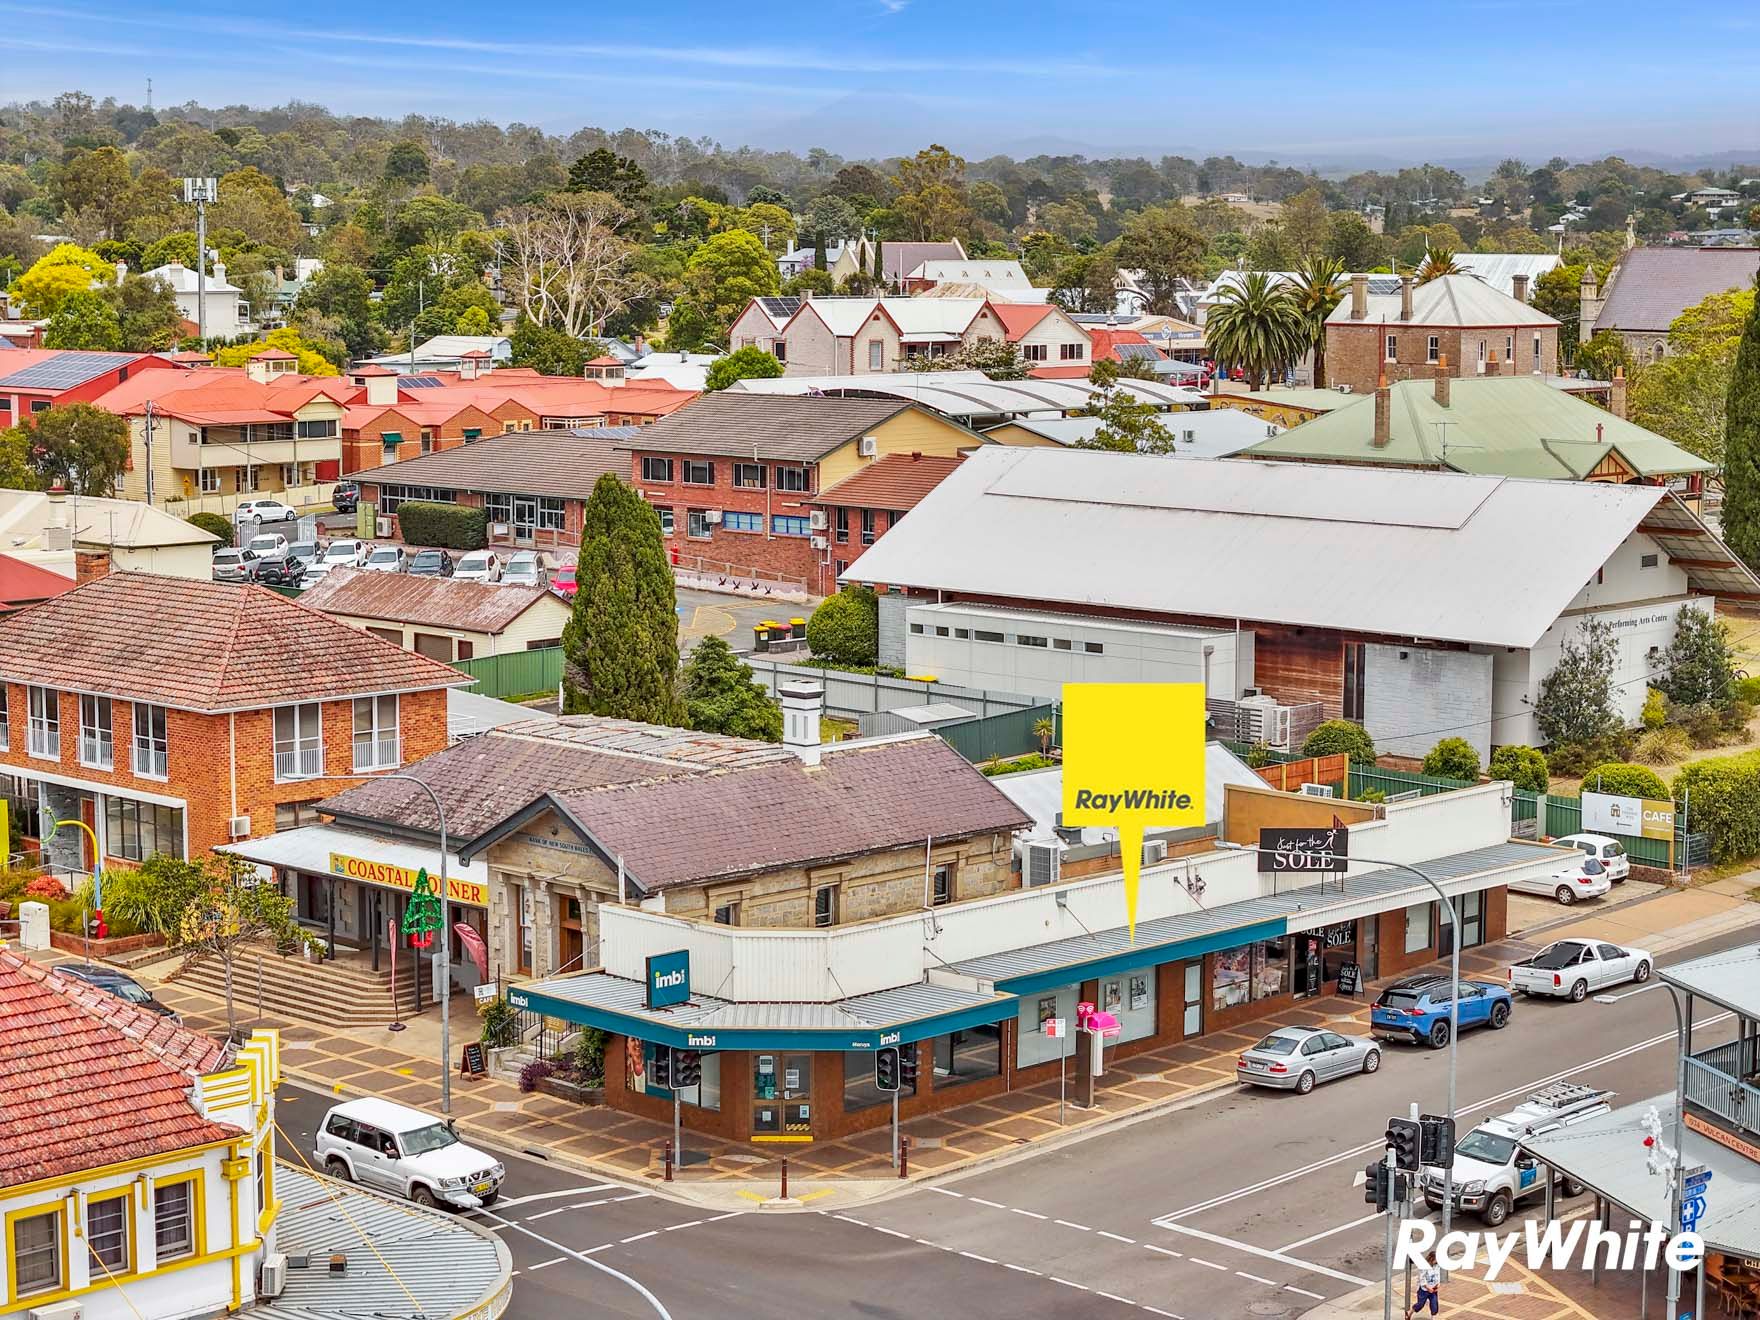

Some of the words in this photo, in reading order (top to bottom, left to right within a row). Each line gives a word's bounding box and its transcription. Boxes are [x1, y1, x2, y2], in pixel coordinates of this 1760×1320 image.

[1638, 617, 1650, 625] Arts
[1650, 614, 1668, 623] Centre
[1642, 810, 1672, 824] CAFE
[529, 836, 542, 844] BANK
[560, 842, 574, 850] SOUTH
[1307, 834, 1322, 847] the
[1273, 850, 1334, 869] SOLE
[348, 859, 413, 888] COASTAL
[1327, 930, 1351, 948] SOLE
[1703, 1125, 1731, 1143] VULCAN
[1731, 1139, 1758, 1158] CENTRE
